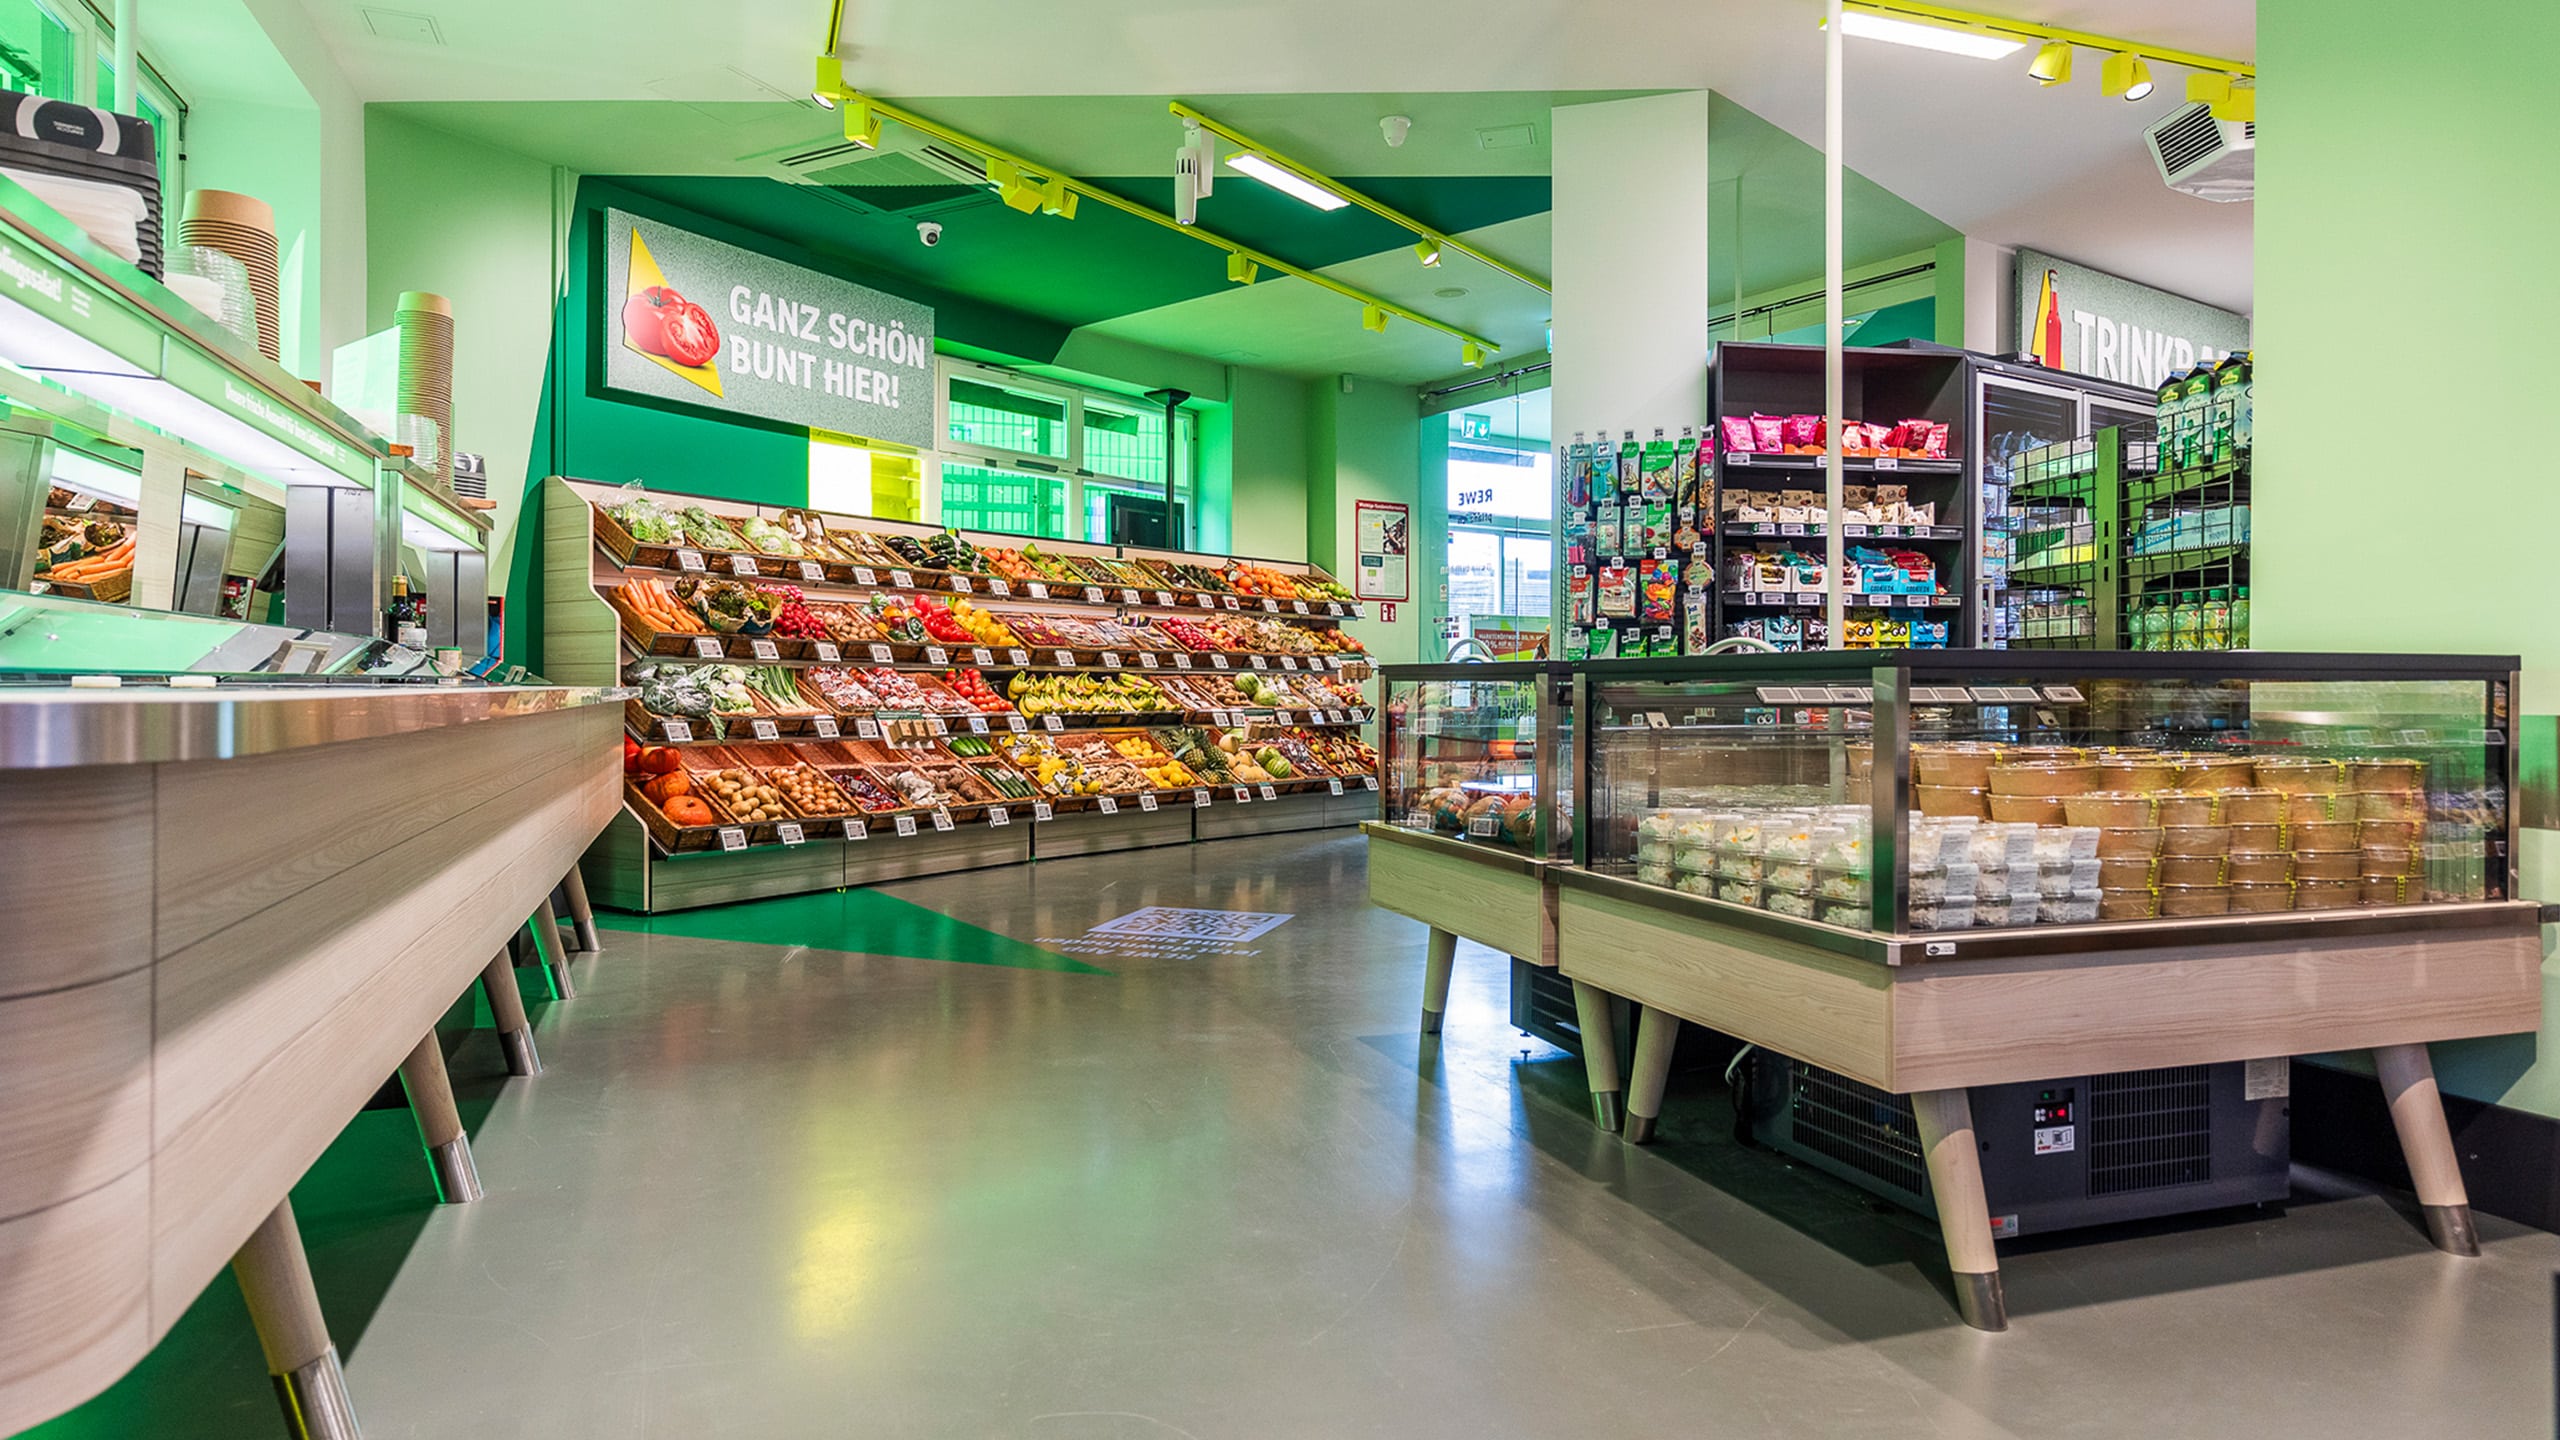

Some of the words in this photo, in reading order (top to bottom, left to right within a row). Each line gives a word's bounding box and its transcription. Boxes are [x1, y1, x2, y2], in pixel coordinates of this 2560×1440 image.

[729, 285, 821, 342] GANZ
[828, 313, 925, 370] SCHÖN
[2073, 310, 2231, 391] TRINKB
[729, 335, 816, 389] BUNT
[824, 359, 900, 409] HIER!
[1033, 937, 1192, 952] downloaden
[1183, 939, 1235, 947] und
[1062, 947, 1116, 955] App
[1117, 950, 1198, 960] REWE
